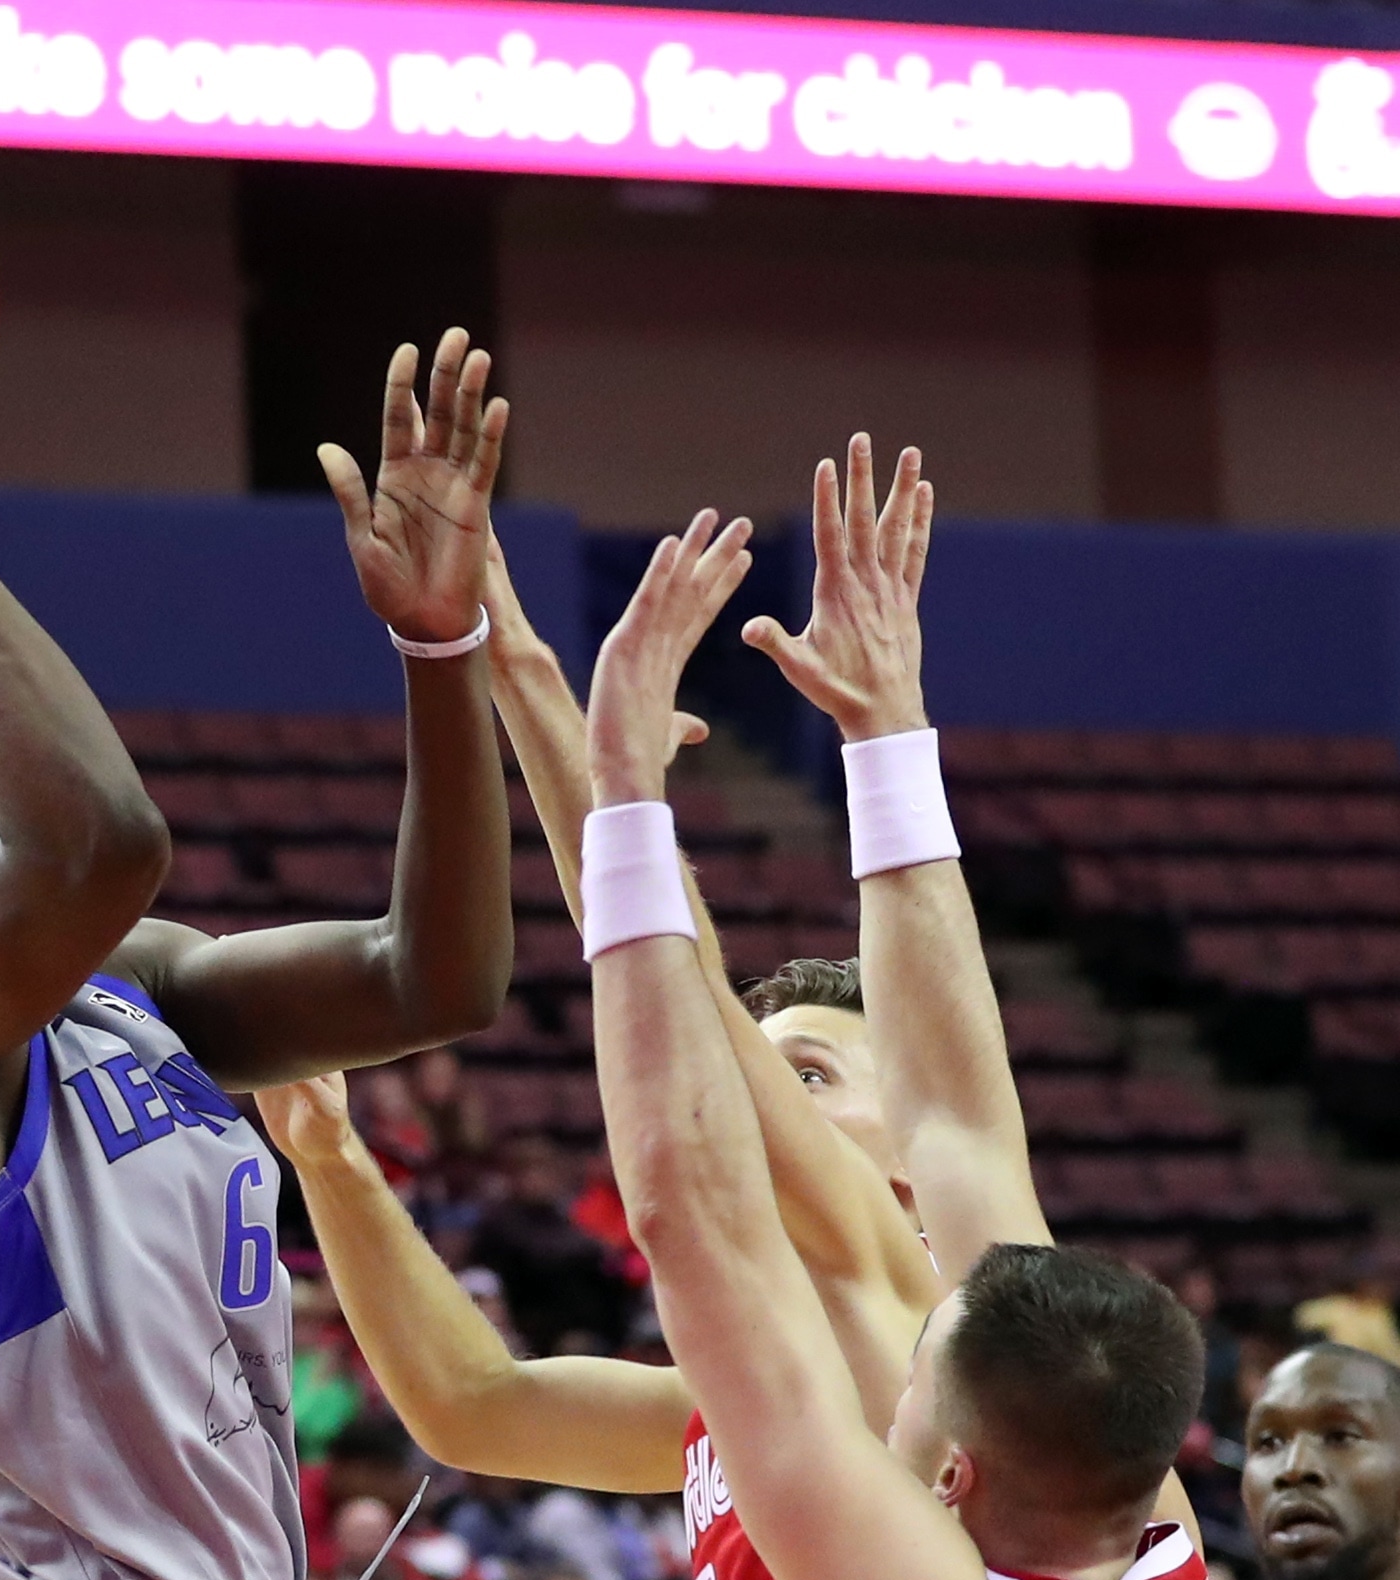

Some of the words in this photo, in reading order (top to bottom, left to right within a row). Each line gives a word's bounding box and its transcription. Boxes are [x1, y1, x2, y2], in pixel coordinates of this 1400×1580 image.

[118, 37, 379, 131] some
[642, 42, 787, 151] for
[218, 1155, 277, 1313] 6
